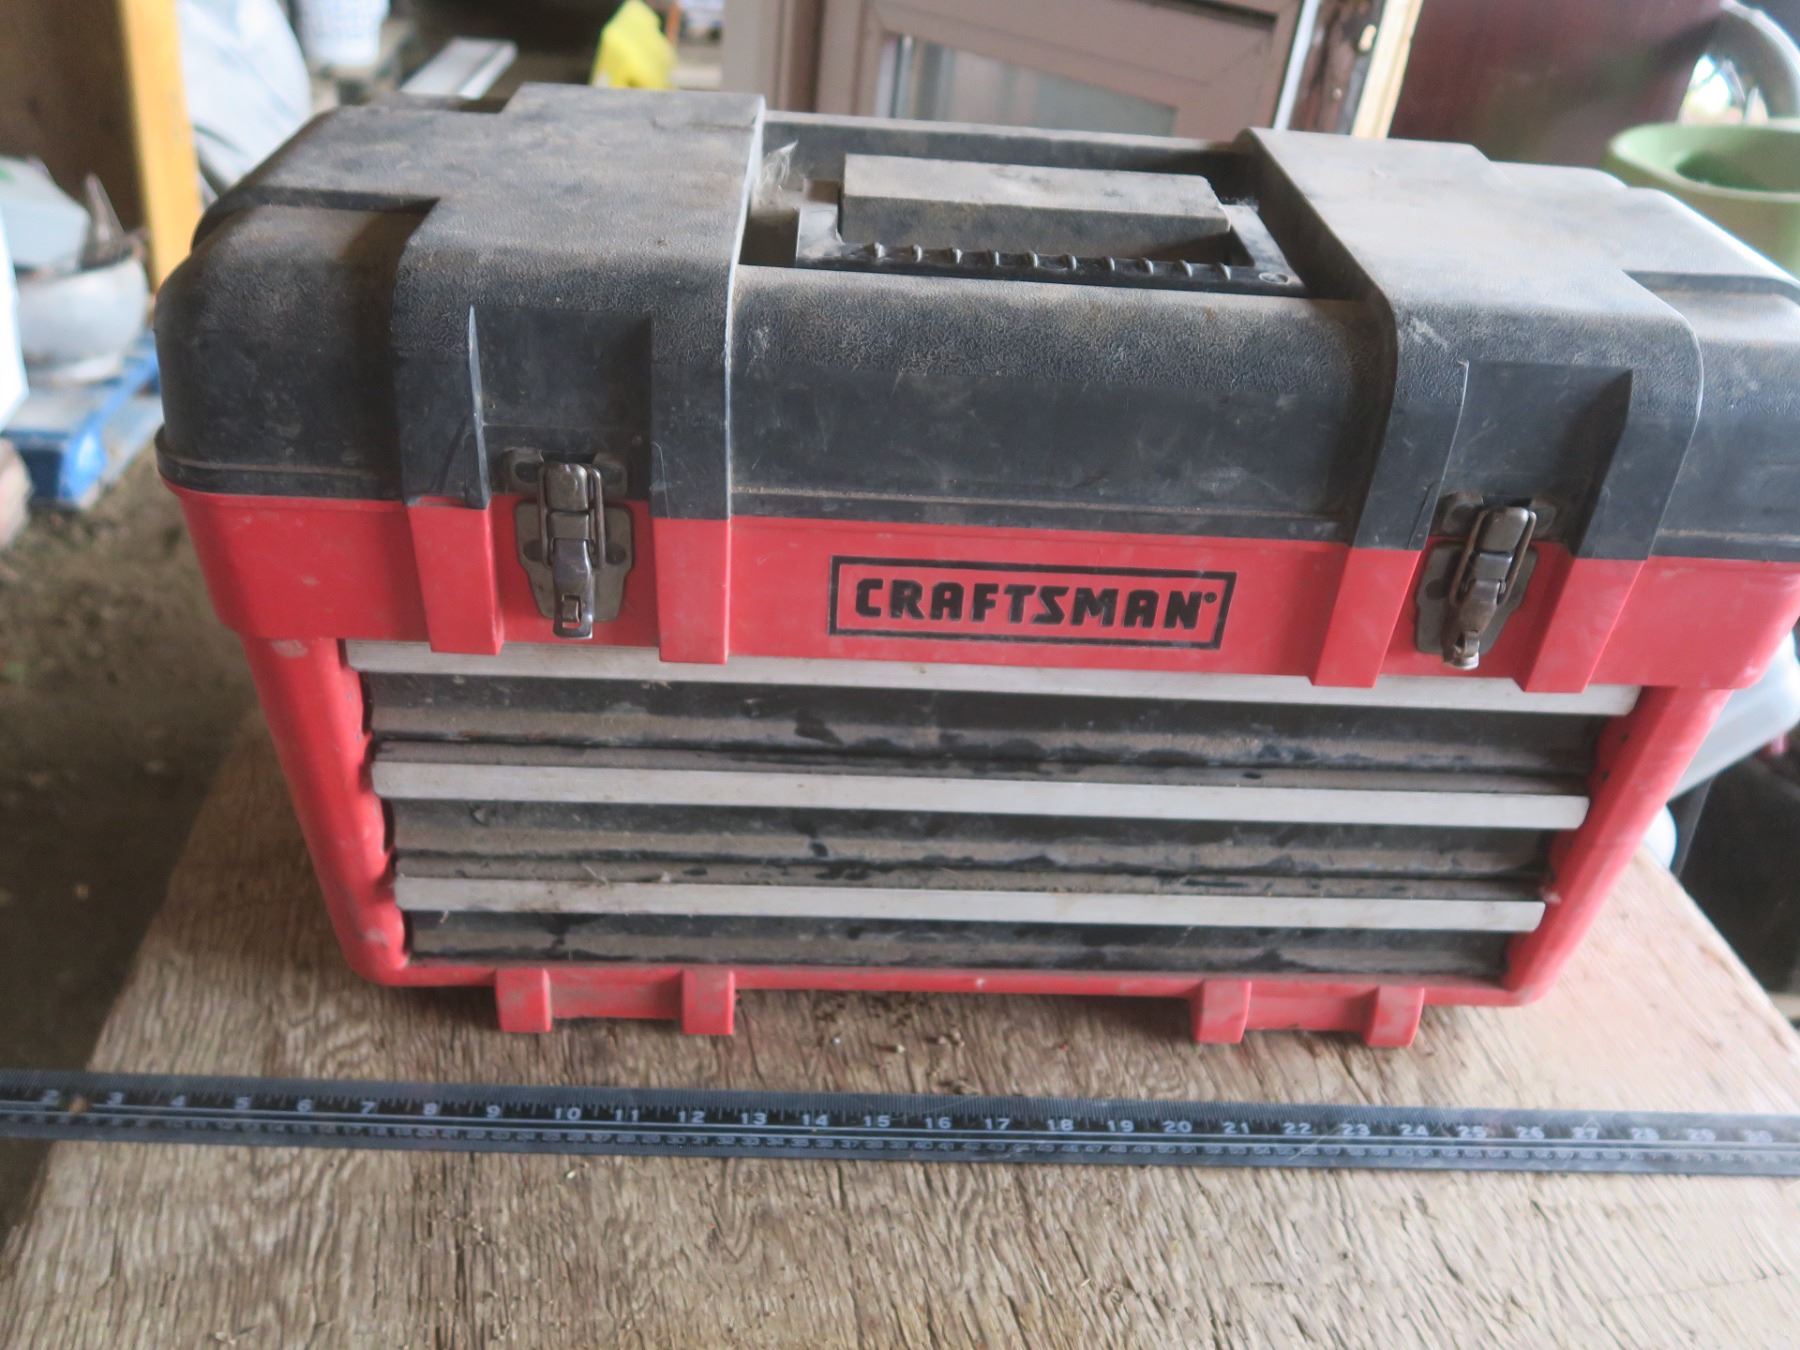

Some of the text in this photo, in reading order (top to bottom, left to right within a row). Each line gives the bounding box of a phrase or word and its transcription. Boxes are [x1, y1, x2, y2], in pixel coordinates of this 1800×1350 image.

[856, 578, 1203, 630] CRAFTSMAN
[107, 1092, 124, 1105] 3
[170, 1095, 186, 1107] 4
[235, 1097, 251, 1110] 5
[297, 1099, 312, 1112] 6
[362, 1101, 375, 1114] 7
[424, 1102, 437, 1116] 8
[486, 1105, 501, 1119] 9
[555, 1107, 581, 1120] 10
[616, 1109, 638, 1122] 11
[679, 1110, 705, 1123] 12
[741, 1112, 767, 1125] 13
[803, 1114, 828, 1126] 14
[864, 1115, 890, 1127] 15
[925, 1117, 951, 1129] 16
[985, 1118, 1010, 1130] 17
[1047, 1119, 1073, 1131] 18
[1107, 1120, 1134, 1132] 19
[1162, 1120, 1192, 1133] 20
[1223, 1121, 1249, 1135] 21
[1283, 1122, 1313, 1135] 22
[1340, 1124, 1370, 1136] 23
[1400, 1124, 1428, 1137] 24
[1457, 1126, 1486, 1139] 25
[1516, 1126, 1544, 1139] 26
